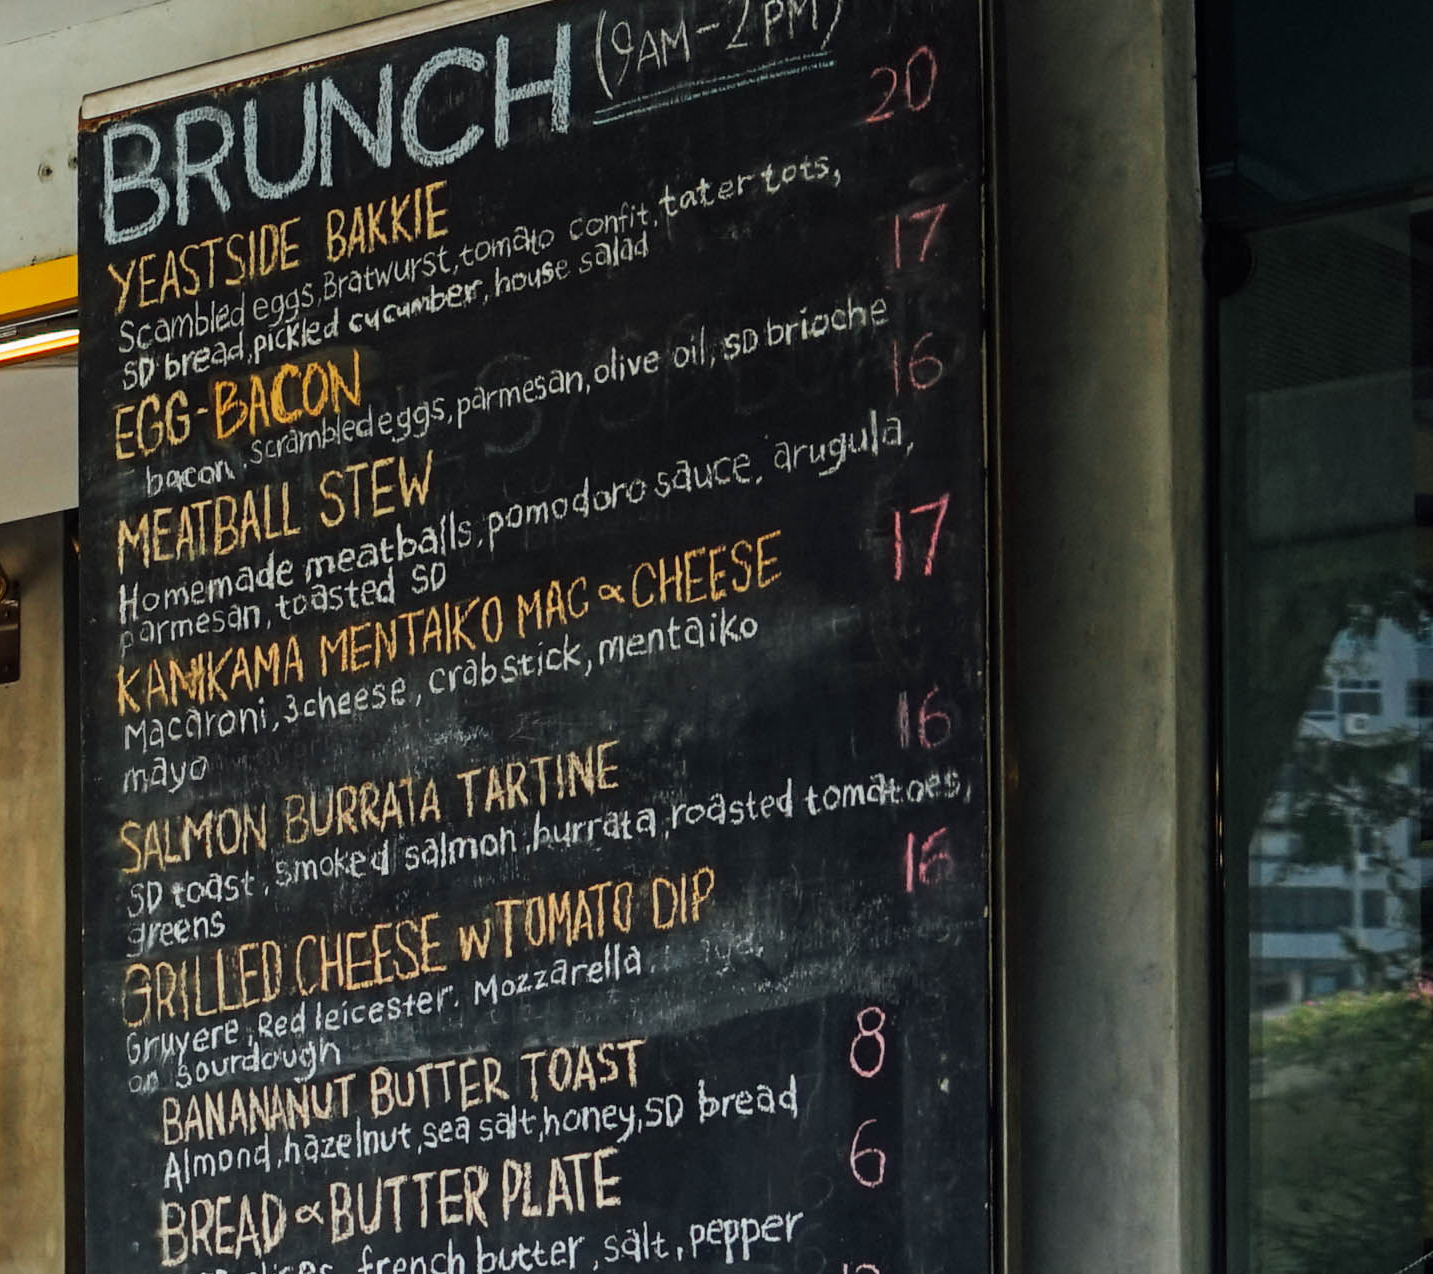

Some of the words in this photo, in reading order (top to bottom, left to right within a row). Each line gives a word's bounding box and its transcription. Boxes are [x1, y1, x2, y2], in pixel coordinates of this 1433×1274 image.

[102, 23, 571, 245] BRUNCH
[862, 44, 937, 123] 20
[106, 217, 301, 314] YEASTSIDE
[326, 180, 449, 263] BAKKIE
[889, 202, 948, 270] 17
[117, 482, 301, 573] MEATBALL
[319, 450, 435, 528] STEW
[893, 492, 951, 581] 17
[320, 596, 502, 678] MENTAIKO
[631, 530, 782, 609] CHEESE
[118, 803, 267, 875] SALMON
[285, 777, 441, 846] BURRATA
[456, 739, 620, 818] TARTINE
[903, 826, 954, 893] 16
[121, 940, 283, 1028] GRILLED
[295, 911, 447, 997] CHEESE
[496, 880, 633, 960] TOMATO
[652, 866, 715, 930] DIP
[162, 1074, 355, 1145] BANANANUT
[370, 1055, 510, 1118] BUTTER
[520, 1039, 646, 1103] TOAST
[849, 1006, 886, 1078] 8
[160, 1191, 287, 1268] BREAD
[330, 1164, 489, 1245] BUTTER
[503, 1145, 622, 1222] PLATE
[849, 1119, 887, 1189] 6
[690, 1210, 804, 1265] pepper
